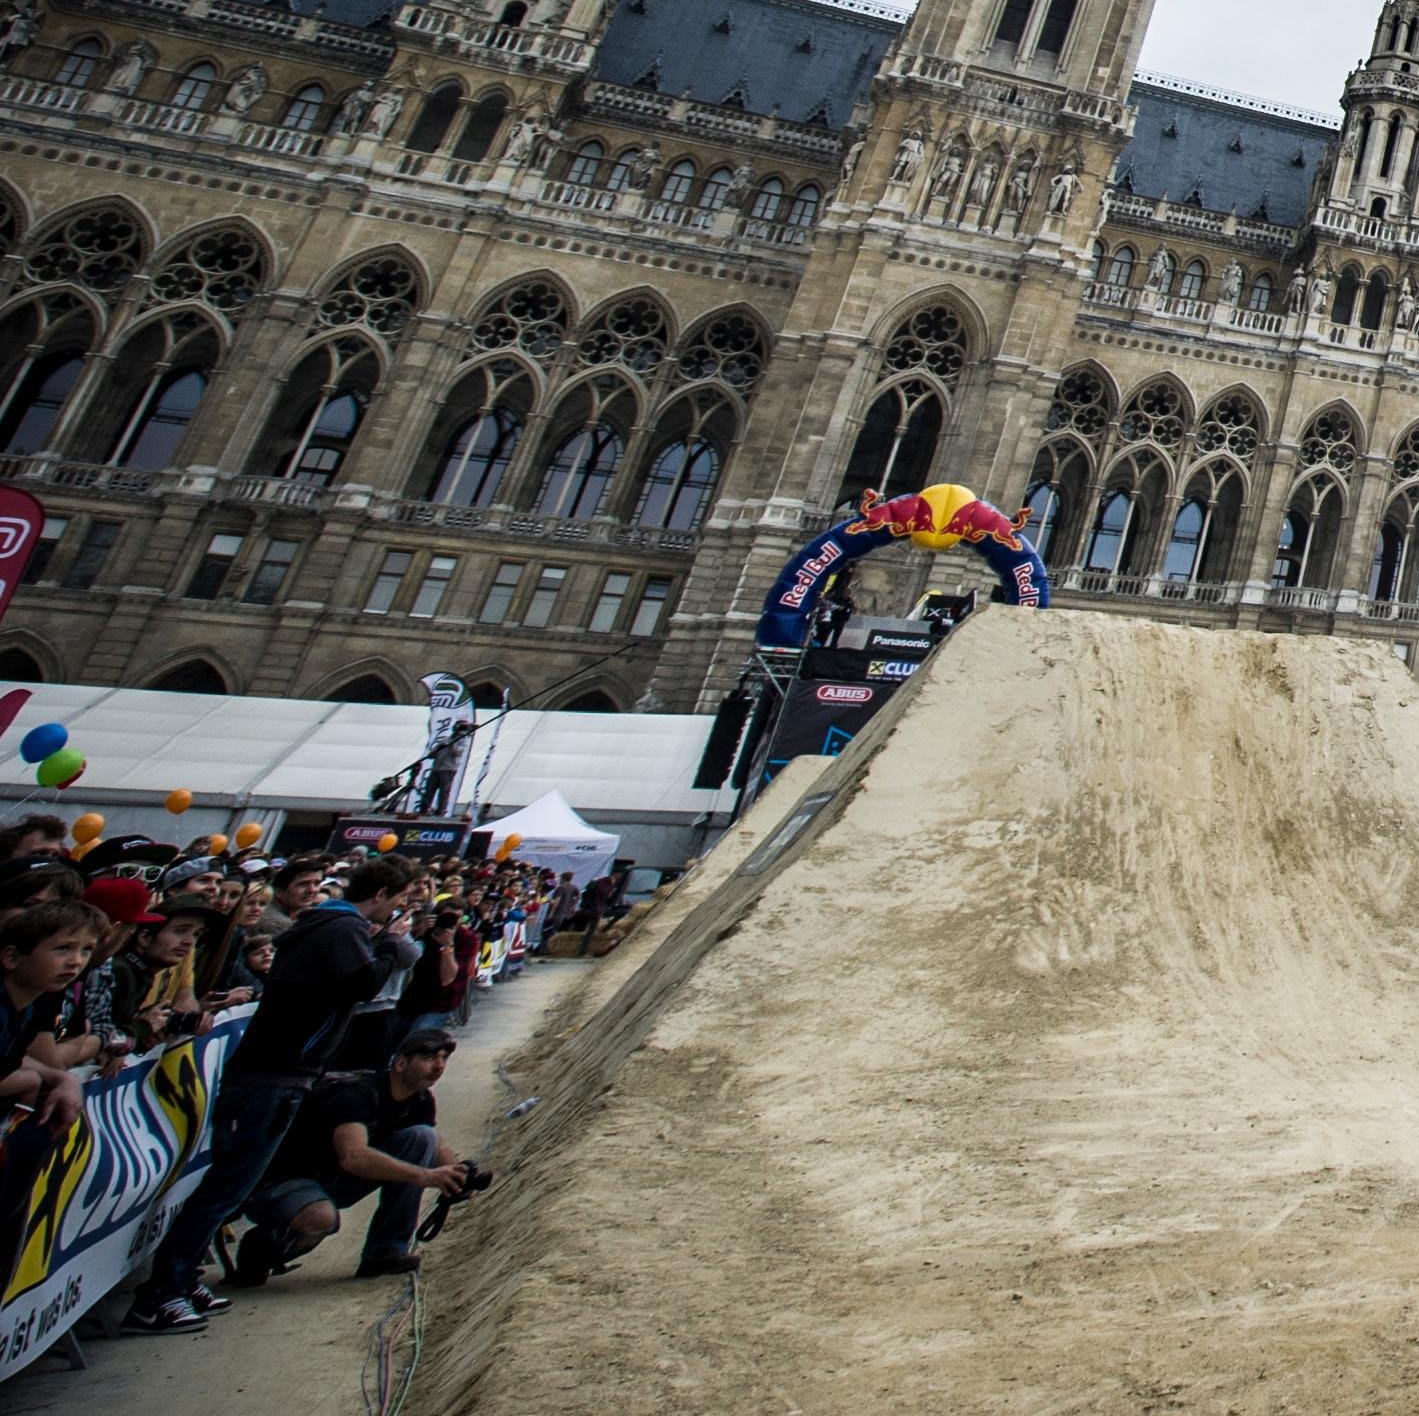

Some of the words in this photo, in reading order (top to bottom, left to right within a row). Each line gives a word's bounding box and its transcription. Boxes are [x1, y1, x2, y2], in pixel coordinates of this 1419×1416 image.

[779, 568, 813, 609] Red
[804, 540, 843, 575] Bull
[1013, 561, 1040, 597] Red
[872, 634, 931, 649] Panasonic
[823, 687, 867, 699] ABUS
[419, 830, 455, 842] CLUB
[59, 1080, 180, 1252] CLUB
